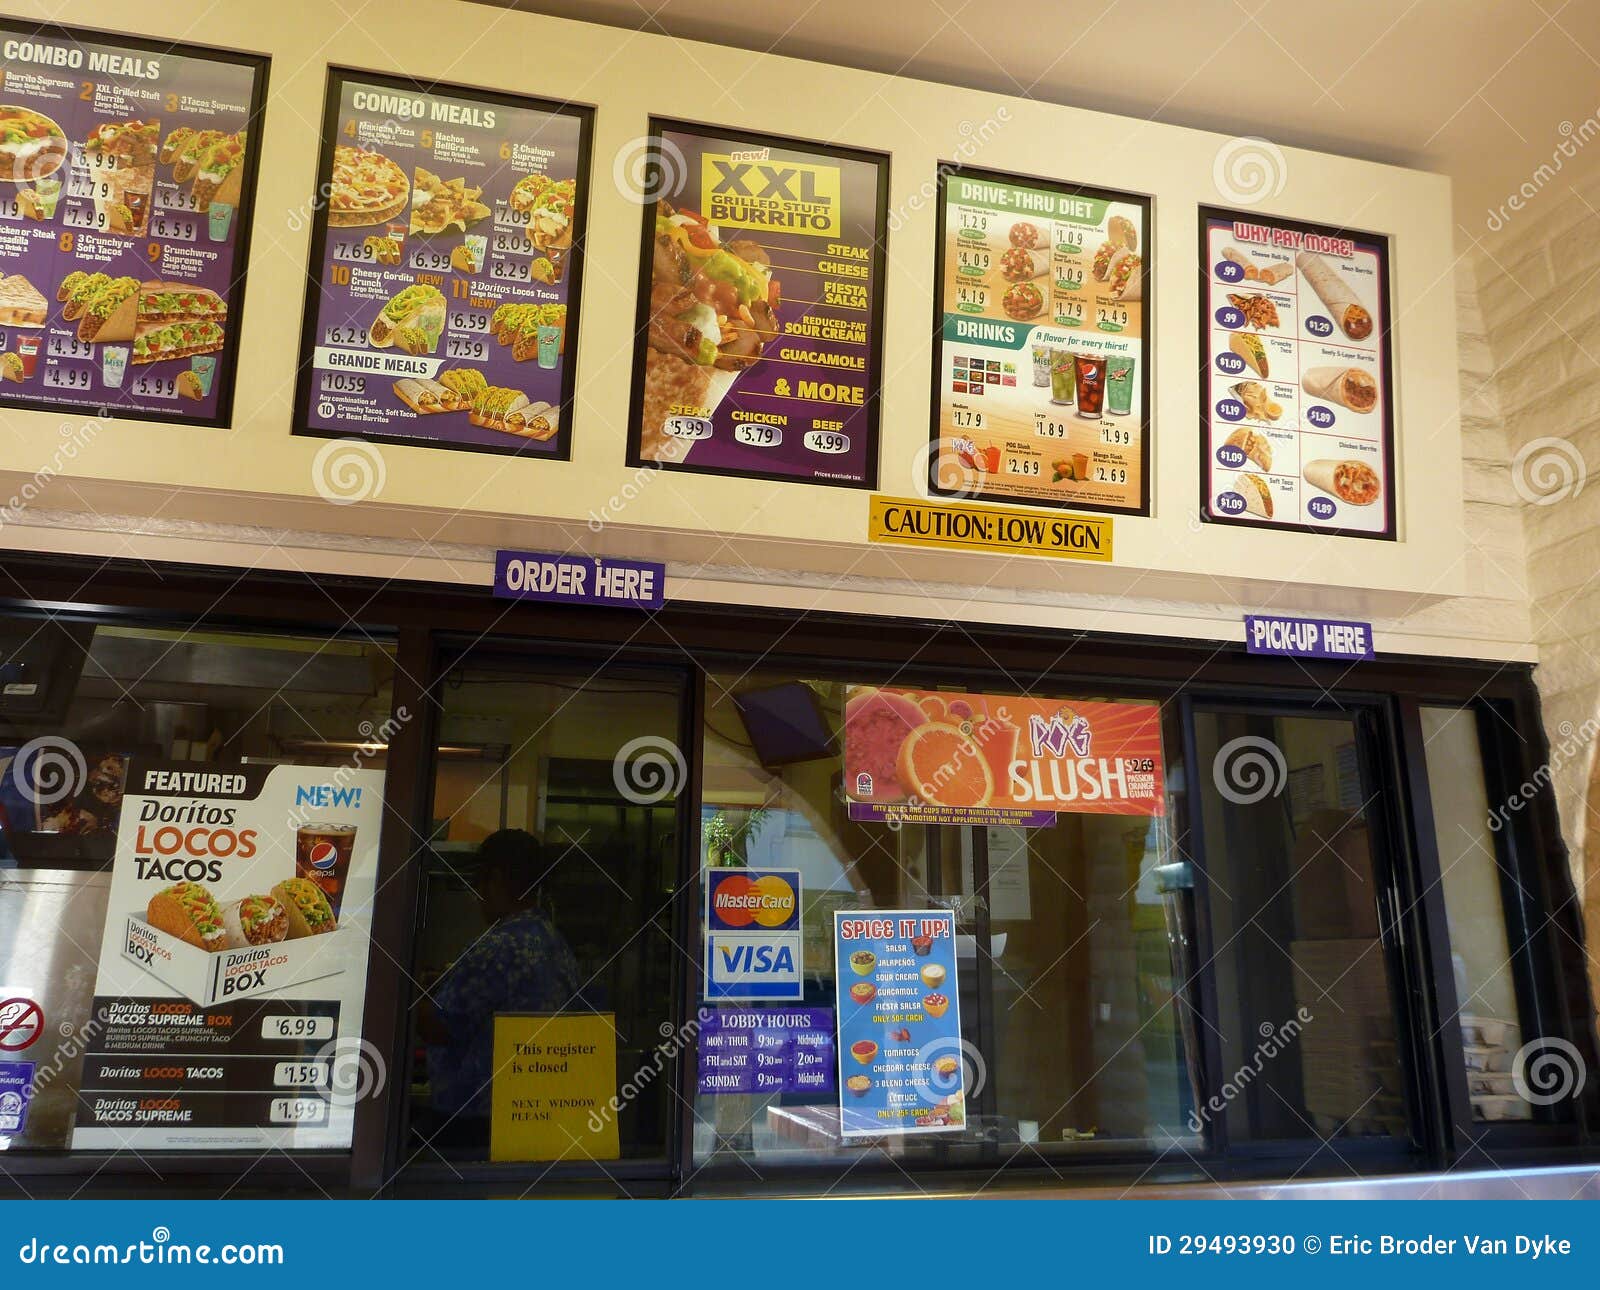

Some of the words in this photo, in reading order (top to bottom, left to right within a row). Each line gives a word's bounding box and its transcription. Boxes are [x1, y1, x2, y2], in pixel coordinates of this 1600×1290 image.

[4, 41, 83, 69] COMBO
[89, 53, 160, 80] MEALS
[79, 82, 94, 101] 2
[96, 84, 110, 95] XXL
[113, 87, 138, 99] Grilled
[96, 93, 124, 104] Burrito
[165, 94, 178, 112] 3
[353, 92, 424, 118] COMBO
[431, 102, 495, 128] MEALS
[344, 120, 356, 138] 4
[436, 132, 465, 143] Nachos
[419, 131, 432, 147] 5
[500, 142, 510, 160] 6
[732, 149, 769, 161] new!
[712, 161, 831, 205] XXL
[159, 190, 197, 209] $6.59
[712, 195, 779, 210] GRILLED
[783, 203, 830, 215] STUFT
[961, 183, 1054, 212] DRIVE-THRU
[1059, 198, 1093, 219] DIET
[67, 210, 105, 228] $7.99
[711, 205, 831, 230] BURRITO
[961, 214, 986, 229] $1.29
[154, 220, 193, 238] $6.59
[59, 234, 73, 252] 8
[87, 236, 123, 249] Crunchy
[1234, 222, 1270, 243] WHY
[1273, 228, 1300, 248] PAY
[1304, 233, 1354, 257] MORE!
[77, 243, 95, 252] Soft
[98, 245, 122, 256] Tacos
[148, 243, 160, 262] 9
[164, 245, 217, 260] Crunchwrap
[827, 244, 869, 260] STEAK
[959, 252, 989, 267] $4.09
[352, 268, 381, 281] Cheesy
[384, 271, 414, 282] Gordita
[417, 273, 444, 285] NEW!
[818, 261, 868, 278] CHEESE
[352, 277, 382, 288] Crunch
[453, 280, 468, 298] 11
[471, 281, 477, 290] 3
[478, 282, 510, 293] Doritos
[512, 286, 534, 296] Locos
[537, 289, 559, 300] Tacos
[824, 281, 867, 297] FIESTA
[826, 295, 866, 308] SALSA
[803, 316, 866, 331] REDUCED-FAT
[957, 320, 1014, 342] DRINKS
[1309, 321, 1330, 333] $1.29
[328, 327, 367, 344] $6.29
[785, 323, 820, 337] SOUR
[822, 328, 866, 342] CREAM
[1044, 332, 1067, 344] flavor
[1068, 334, 1080, 345] for
[1082, 337, 1103, 349] every
[1105, 338, 1128, 350] thirst!
[51, 337, 91, 355] $4.99
[329, 353, 380, 369] GRANDE
[385, 358, 427, 373] MEALS
[780, 349, 864, 368] GUACAMOLE
[1220, 358, 1241, 369] $1.09
[49, 368, 88, 387] $4.99
[137, 378, 175, 395] $5.99
[774, 379, 790, 395] &
[798, 381, 864, 404] MORE
[321, 404, 332, 415] 10
[670, 404, 711, 418] STEAK
[732, 411, 787, 425] CHICKEN
[1221, 405, 1239, 415] $1.19
[671, 418, 704, 436] $5.99
[813, 420, 843, 430] BEEF
[955, 412, 981, 426] $1.79
[742, 426, 773, 443] $5.79
[1037, 422, 1063, 437] $1.89
[1103, 430, 1129, 443] $1.99
[811, 434, 842, 450] $4.99
[1221, 451, 1242, 462] $1.09
[1009, 459, 1038, 473] $2.69
[1097, 468, 1125, 482] $2.69
[1221, 498, 1242, 509] $1.09
[1312, 503, 1332, 513] $1.89
[884, 507, 993, 542] CAUTION:
[998, 518, 1046, 544] LOW
[1051, 522, 1101, 549] SIGN
[505, 559, 586, 596] ORDER
[597, 565, 654, 600] HERE
[1253, 620, 1317, 651] PICK-UP
[1323, 625, 1366, 654] HERE
[1029, 714, 1091, 758] POG
[144, 771, 246, 794] FEATURED
[1008, 758, 1127, 802] SLUSH
[296, 785, 363, 808] NEW!
[140, 800, 236, 825] Doritos
[136, 825, 257, 858] LOCOS
[135, 857, 223, 882] TACOS
[309, 869, 335, 878] pepsi
[716, 893, 792, 908] MasterCard
[842, 920, 893, 939] SPICE
[900, 920, 916, 938] IT
[921, 919, 949, 938] UP!
[128, 941, 154, 966] BOX
[227, 949, 270, 967] Doritos
[718, 946, 794, 973] VISA
[225, 963, 257, 977] LOCOS
[259, 955, 288, 970] TACOS
[223, 969, 266, 996] BOX
[109, 1003, 150, 1014] Doritos
[152, 1004, 191, 1014] LOCOS
[876, 1002, 898, 1010] FIESTA
[900, 1002, 920, 1010] SALSA
[109, 1014, 146, 1025] TACOS
[148, 1015, 203, 1025] SUPREME
[207, 1016, 232, 1025] BOX
[276, 1019, 316, 1036] $6.99
[722, 1015, 764, 1027] LOBBY
[767, 1015, 810, 1027] HOURS
[513, 1044, 541, 1055] This
[547, 1046, 596, 1057] register
[884, 1048, 920, 1057] TOMATOES
[100, 1067, 141, 1078] Doritos
[144, 1068, 184, 1078] LOCOS
[187, 1068, 223, 1078] TACOS
[284, 1066, 318, 1083] $1.59
[513, 1063, 522, 1073] is
[529, 1062, 568, 1073] closed
[96, 1099, 137, 1110] Doritos
[140, 1100, 180, 1110] LOCOS
[278, 1102, 317, 1119] $1.99
[512, 1100, 541, 1108] NEXT
[94, 1111, 133, 1121] TACOS
[135, 1111, 192, 1121] SUPREME
[512, 1113, 550, 1121] PLEASE
